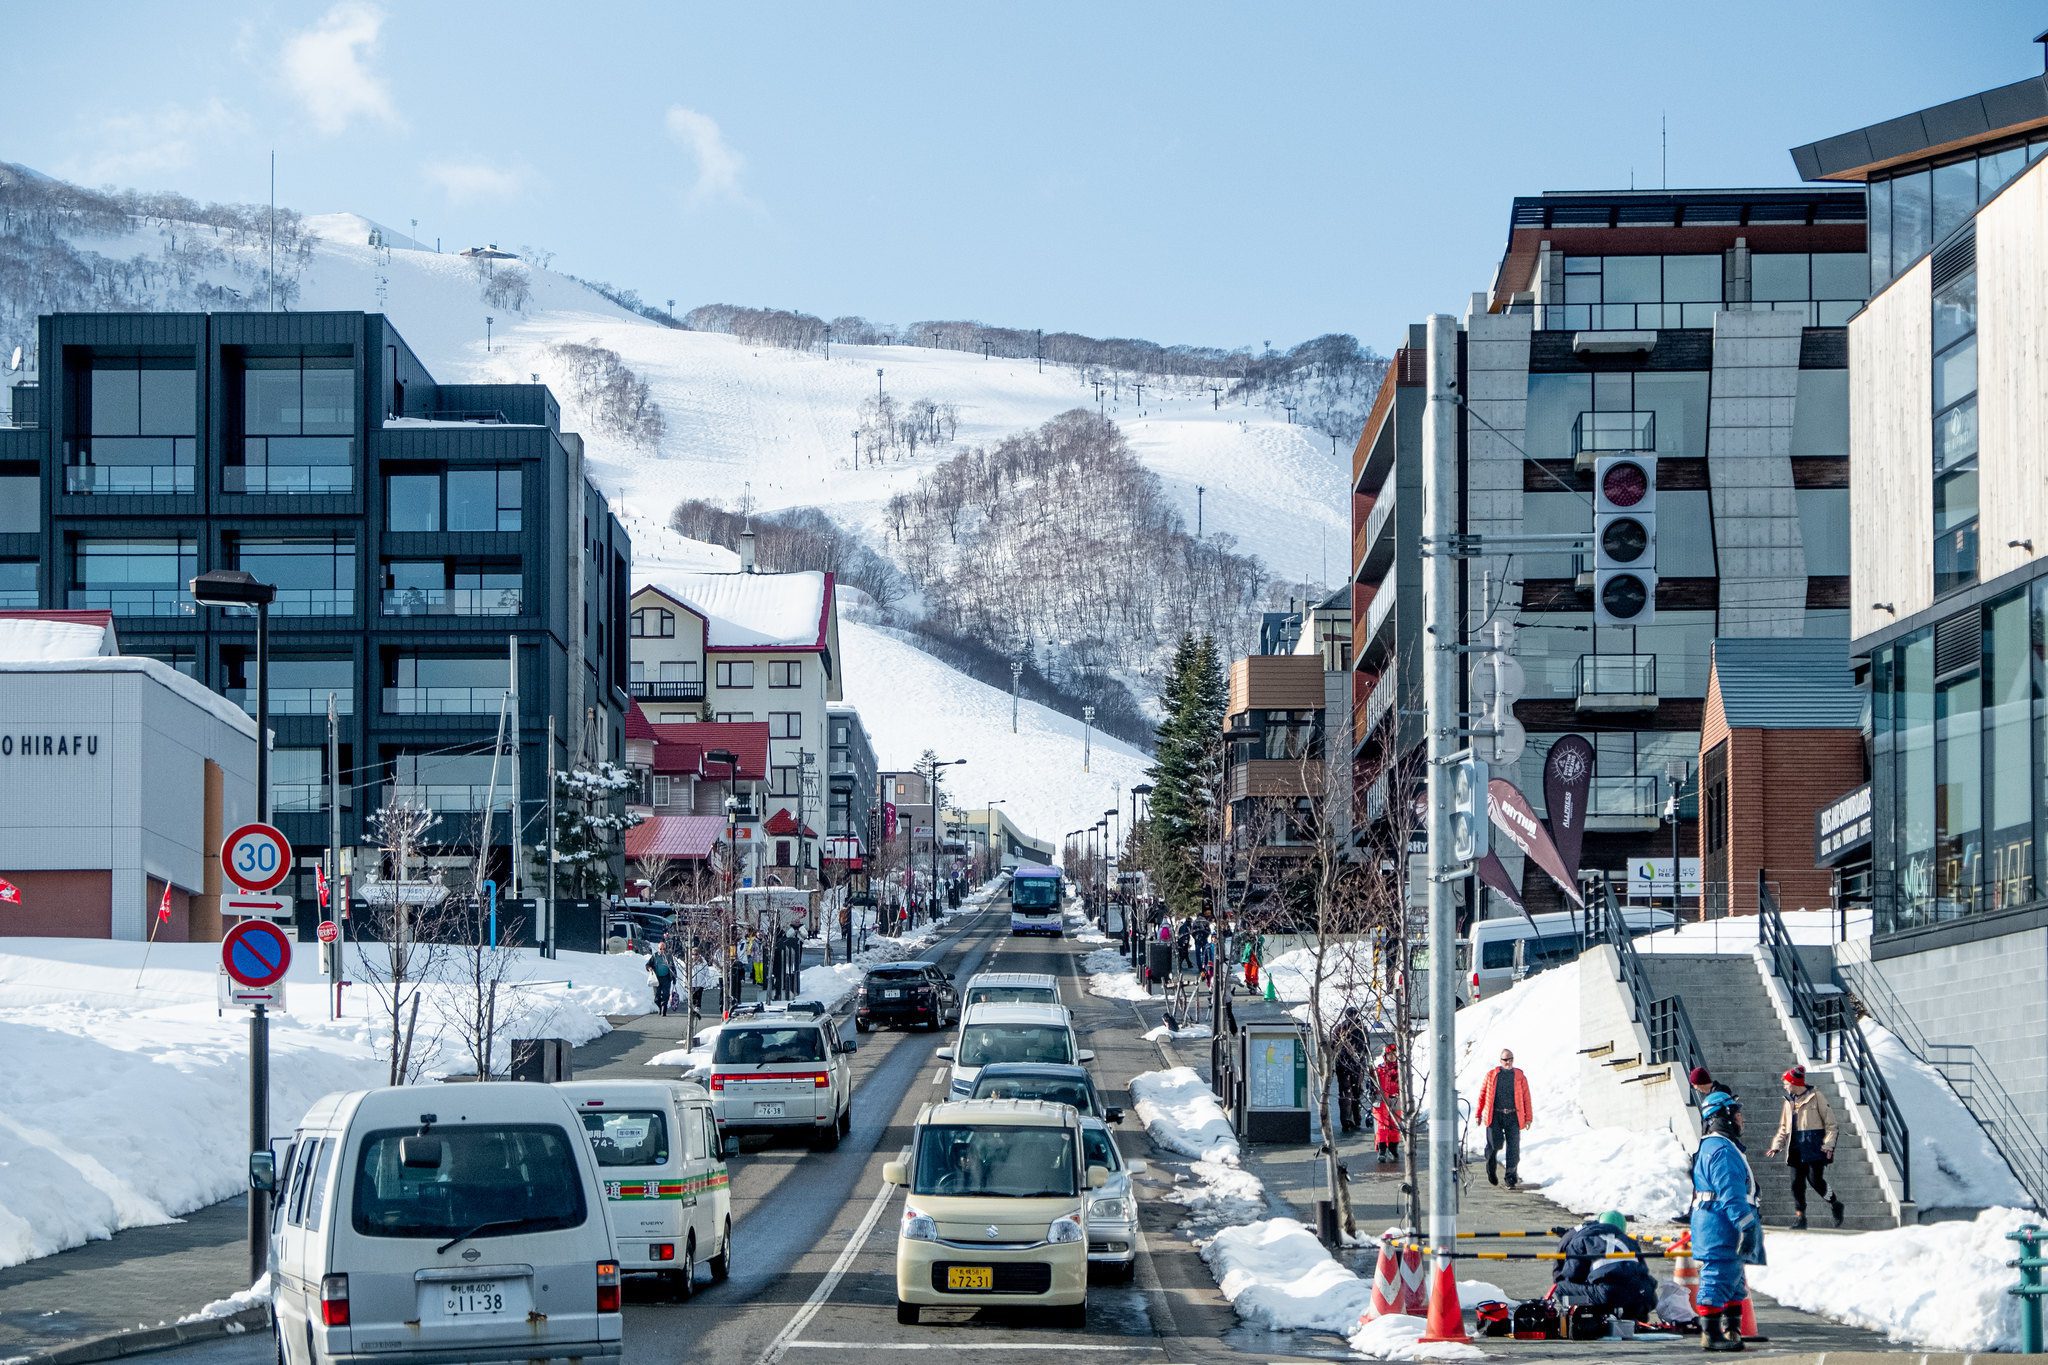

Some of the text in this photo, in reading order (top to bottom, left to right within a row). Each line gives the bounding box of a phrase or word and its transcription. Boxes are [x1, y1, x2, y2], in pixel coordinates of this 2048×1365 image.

[2, 735, 97, 756] O HIRAFU
[1502, 800, 1537, 835] RHYTHM
[238, 843, 276, 872] 30
[958, 1276, 989, 1288] 72-31
[459, 1294, 503, 1312] 11-38
